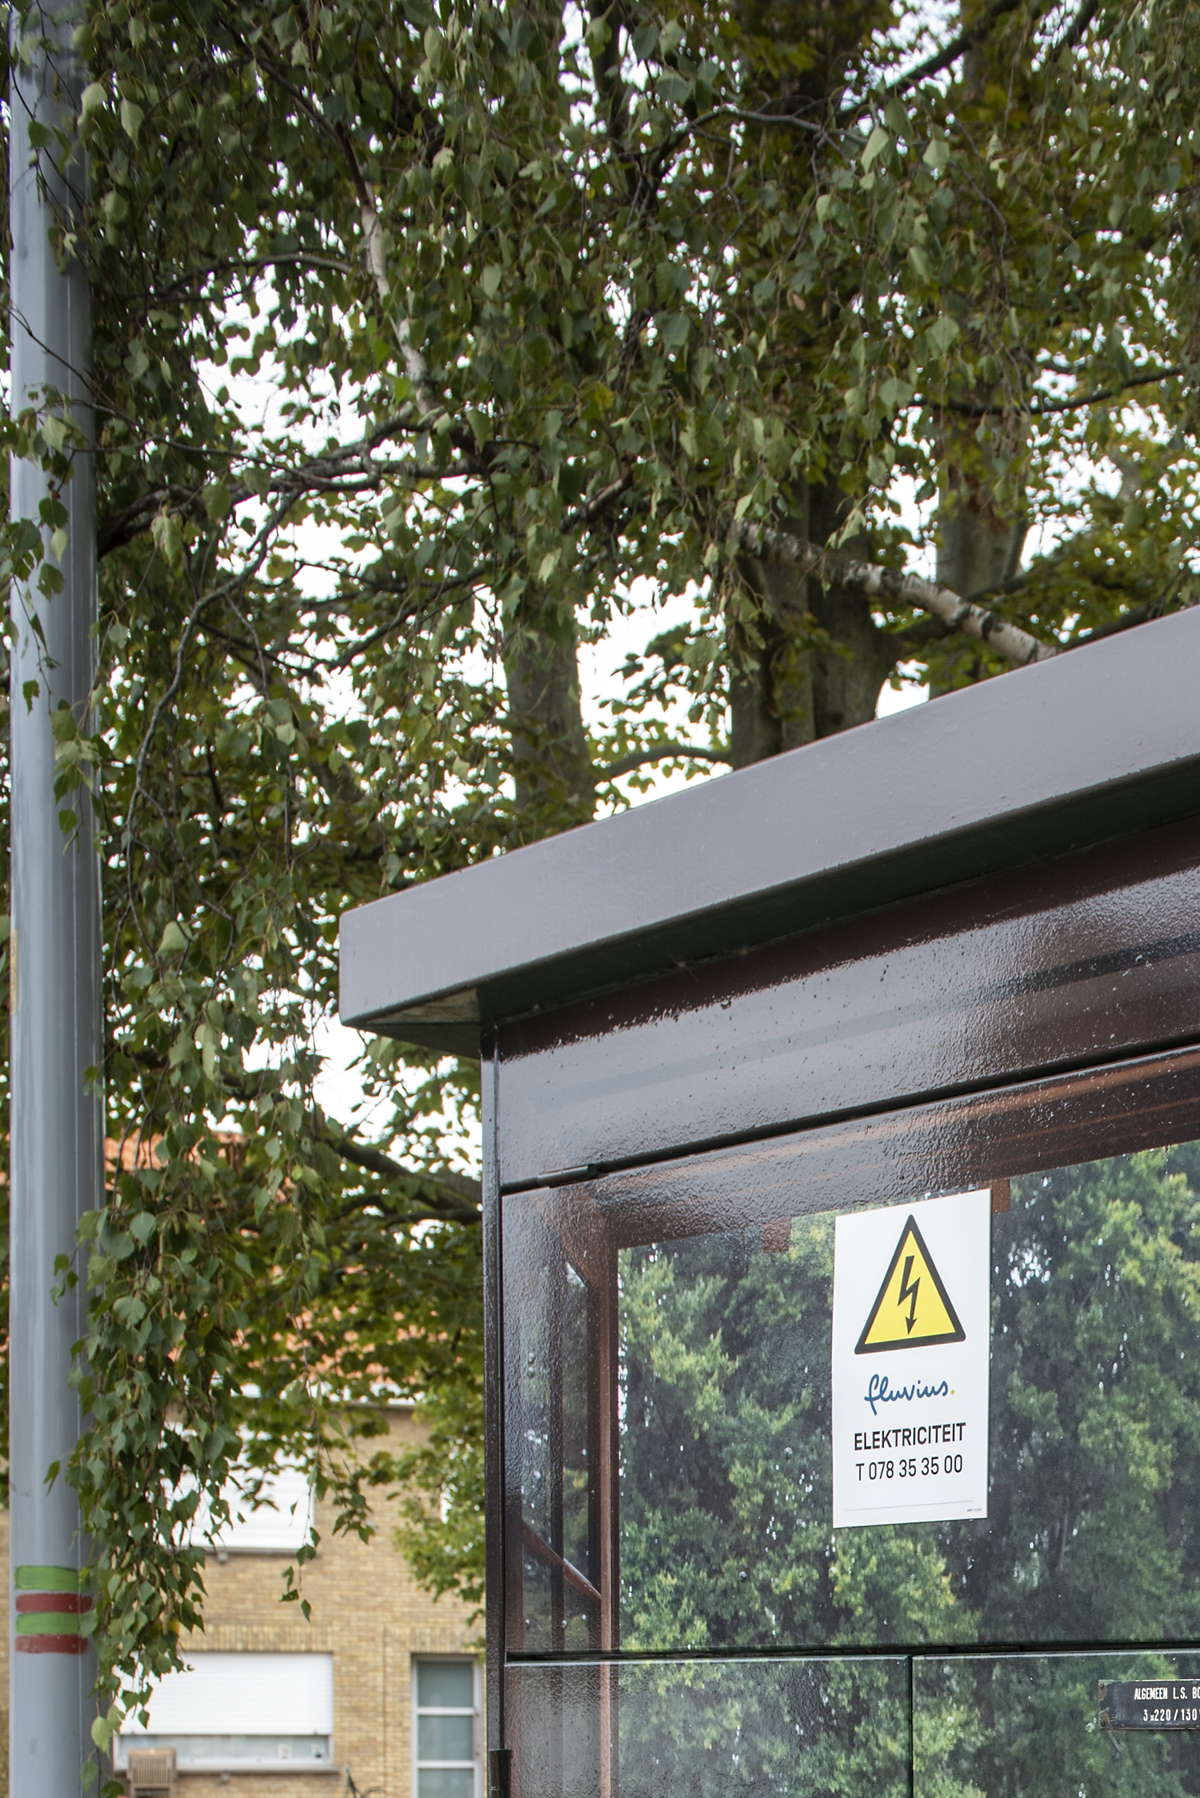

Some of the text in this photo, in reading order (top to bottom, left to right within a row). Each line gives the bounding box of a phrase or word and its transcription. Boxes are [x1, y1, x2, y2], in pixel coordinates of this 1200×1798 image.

[854, 1422, 966, 1451] ELEKTRICITEIT
[856, 1454, 963, 1481] T 078 35 35 00
[1134, 1687, 1168, 1700] ALGEMEEN
[1172, 1686, 1188, 1700] L.S.
